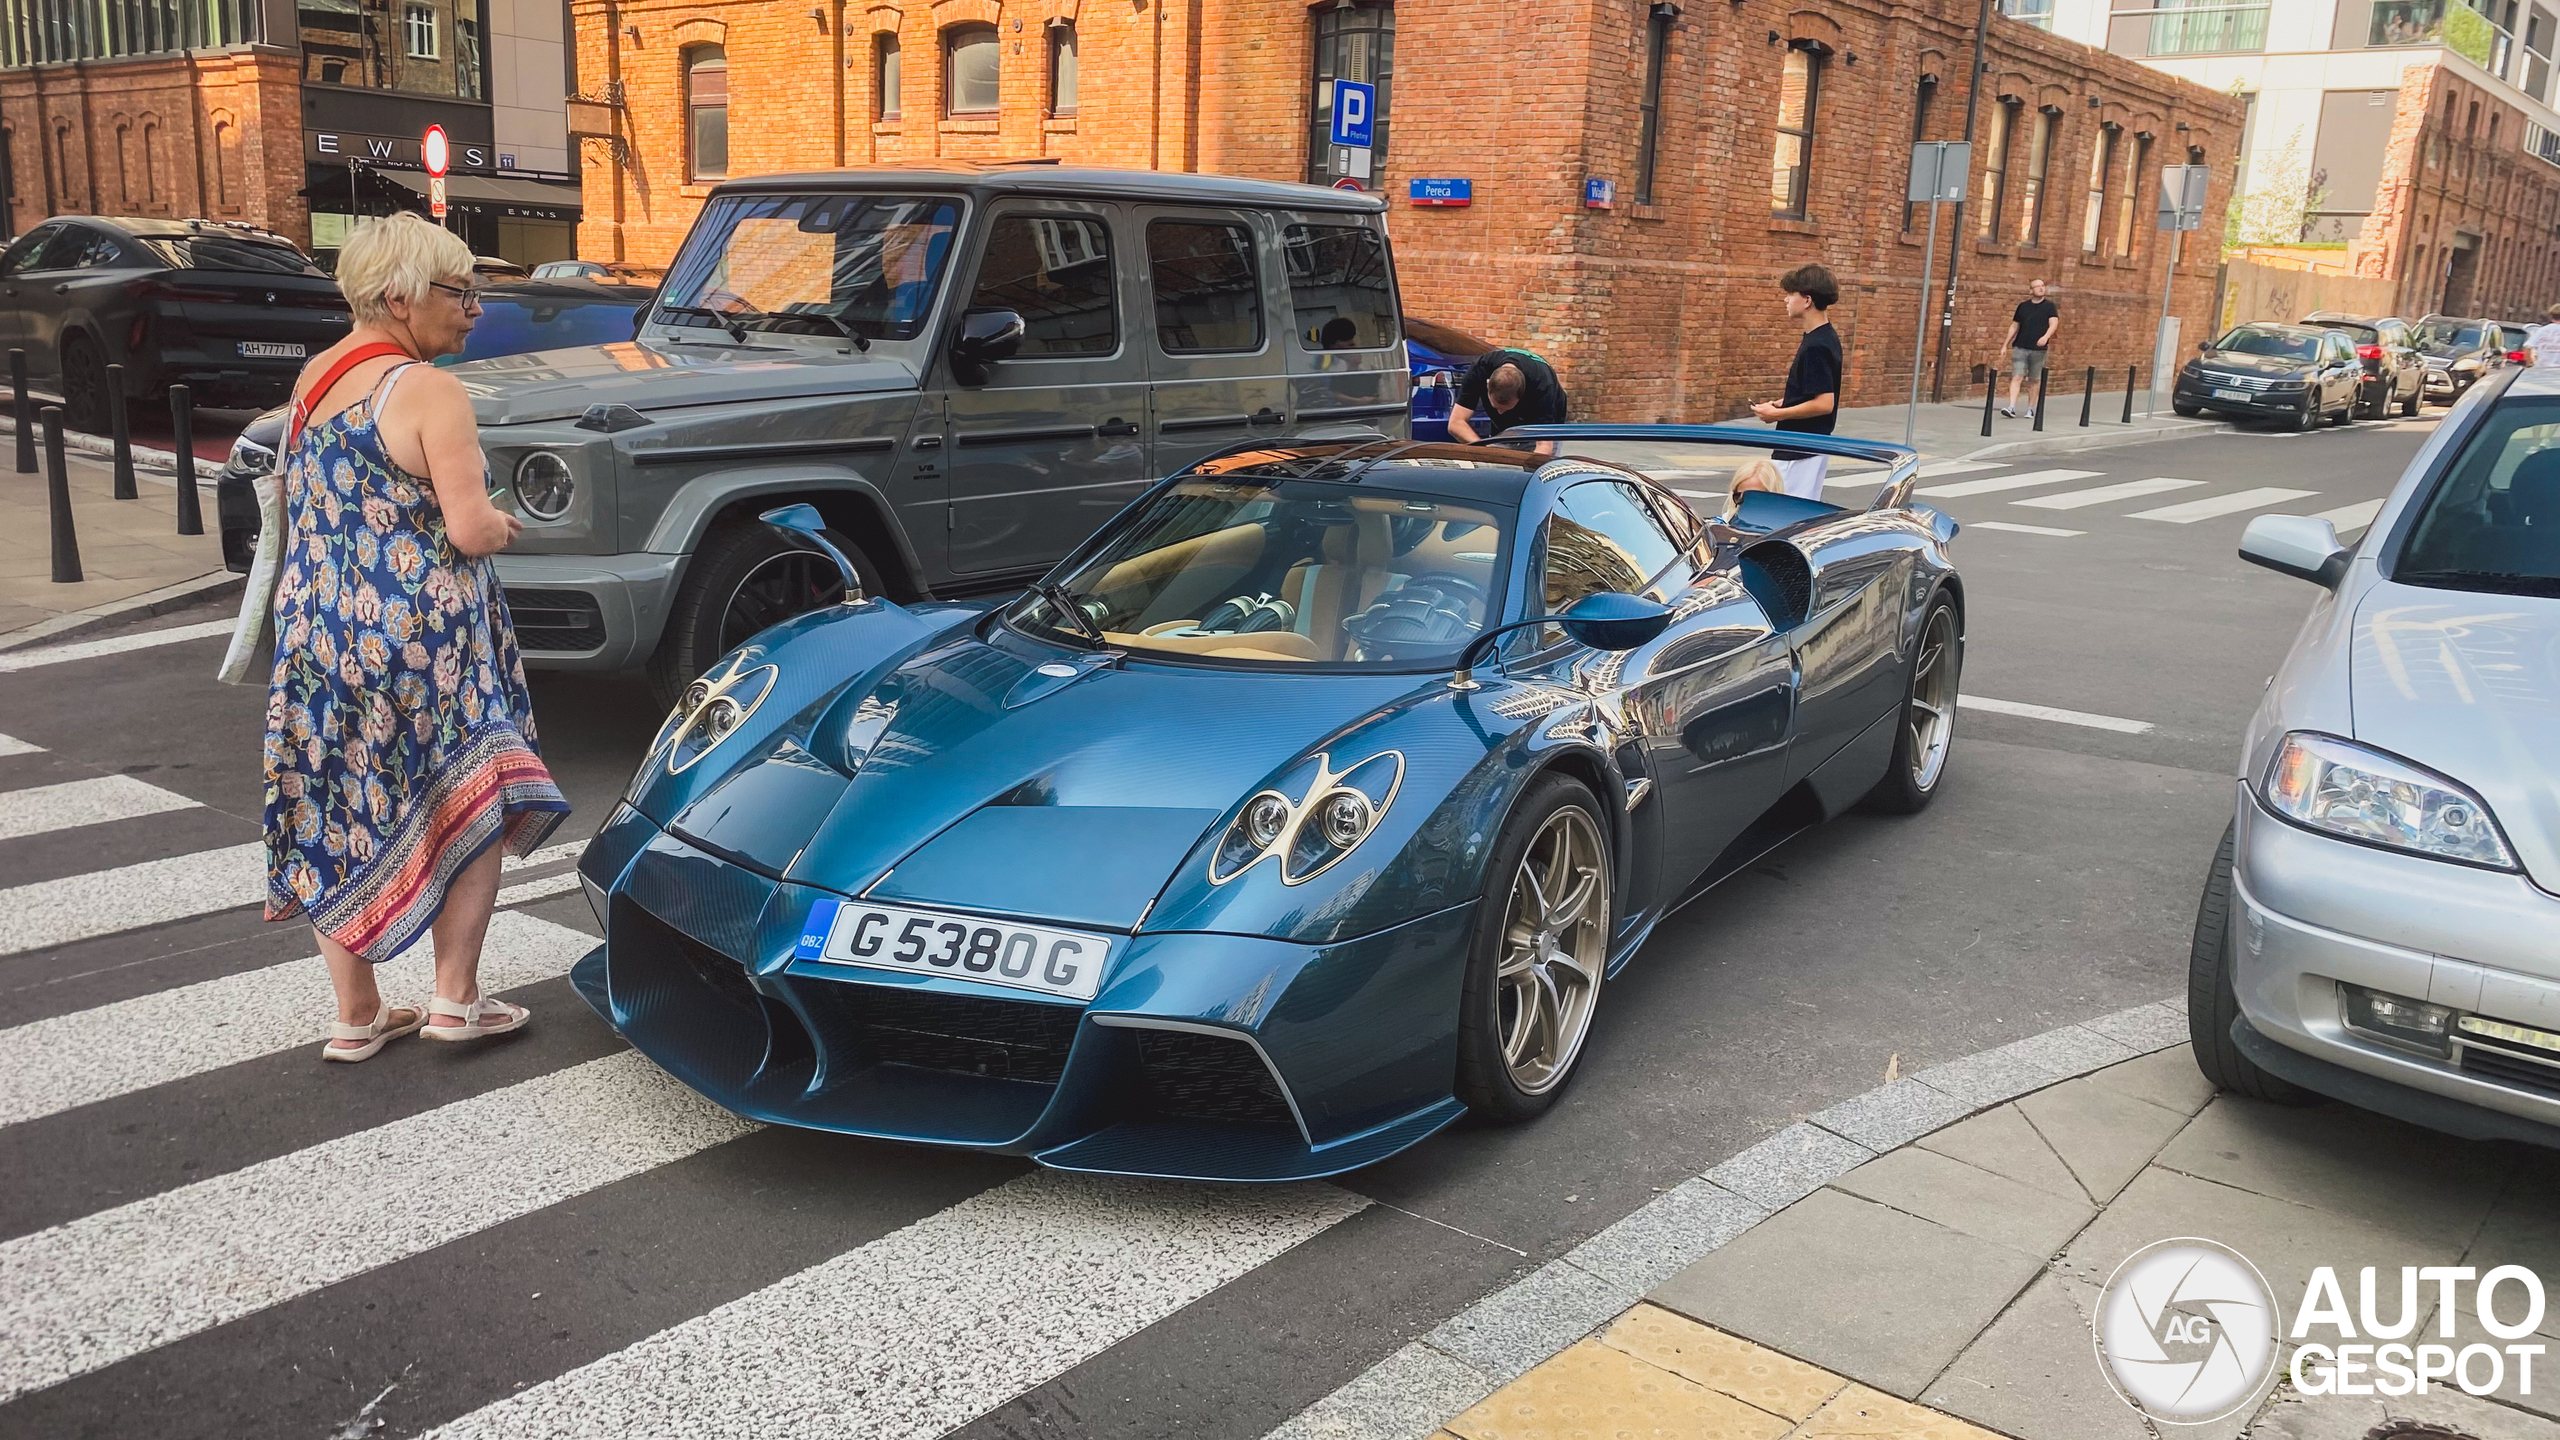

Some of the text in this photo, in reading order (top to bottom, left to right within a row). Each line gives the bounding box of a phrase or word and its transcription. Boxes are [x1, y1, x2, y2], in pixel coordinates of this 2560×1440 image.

[1341, 88, 1365, 137] P
[318, 134, 484, 166] EWS
[503, 158, 512, 167] 11
[1425, 185, 1451, 196] Pereca
[446, 205, 482, 213] WNS
[508, 208, 556, 218] EWNS
[801, 934, 824, 949] GBZ
[850, 912, 1083, 986] G 5380 G
